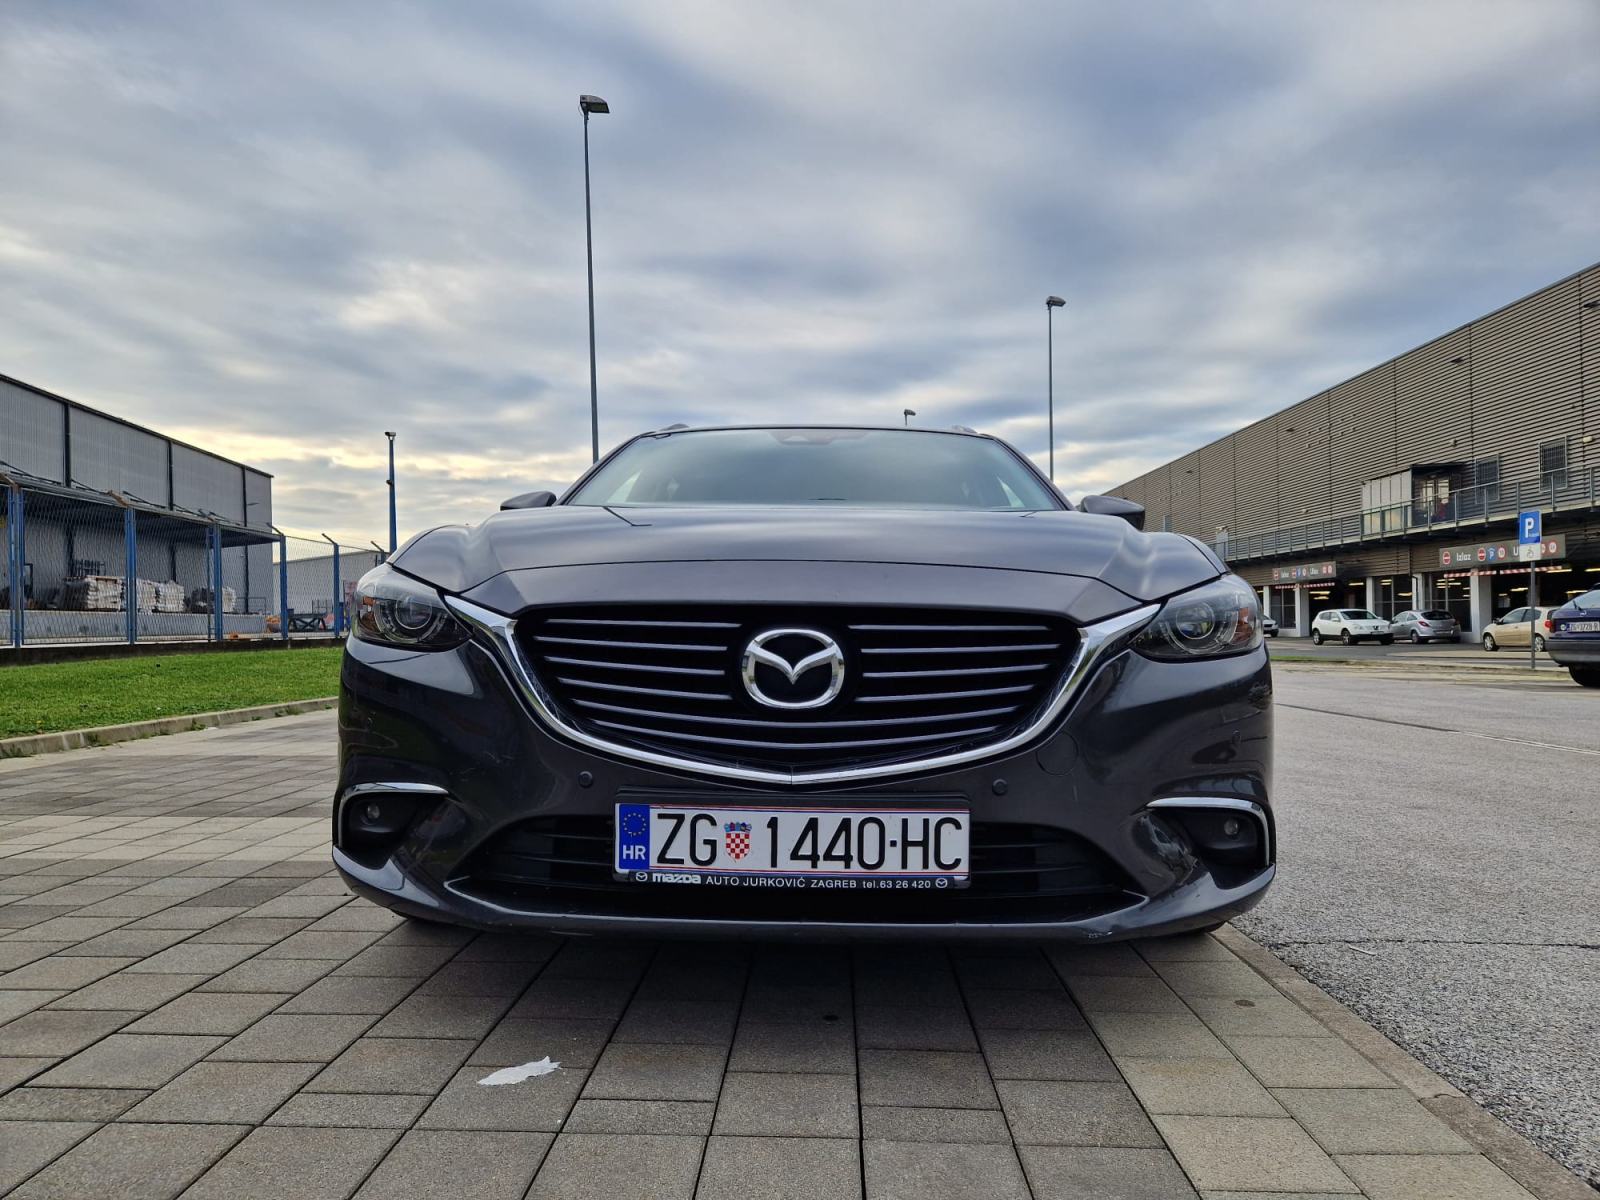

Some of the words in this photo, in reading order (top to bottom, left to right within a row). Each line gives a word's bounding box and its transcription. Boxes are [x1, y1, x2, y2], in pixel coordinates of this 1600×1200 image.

[1526, 517, 1534, 538] P
[1456, 552, 1471, 561] Izlaz
[657, 813, 718, 867] ZG
[622, 844, 646, 860] HR
[652, 872, 702, 885] mazda
[705, 876, 740, 886] AUTO
[743, 876, 806, 888] JURKOVIĆ
[810, 879, 857, 888] ZAGREB
[911, 880, 931, 888] 420
